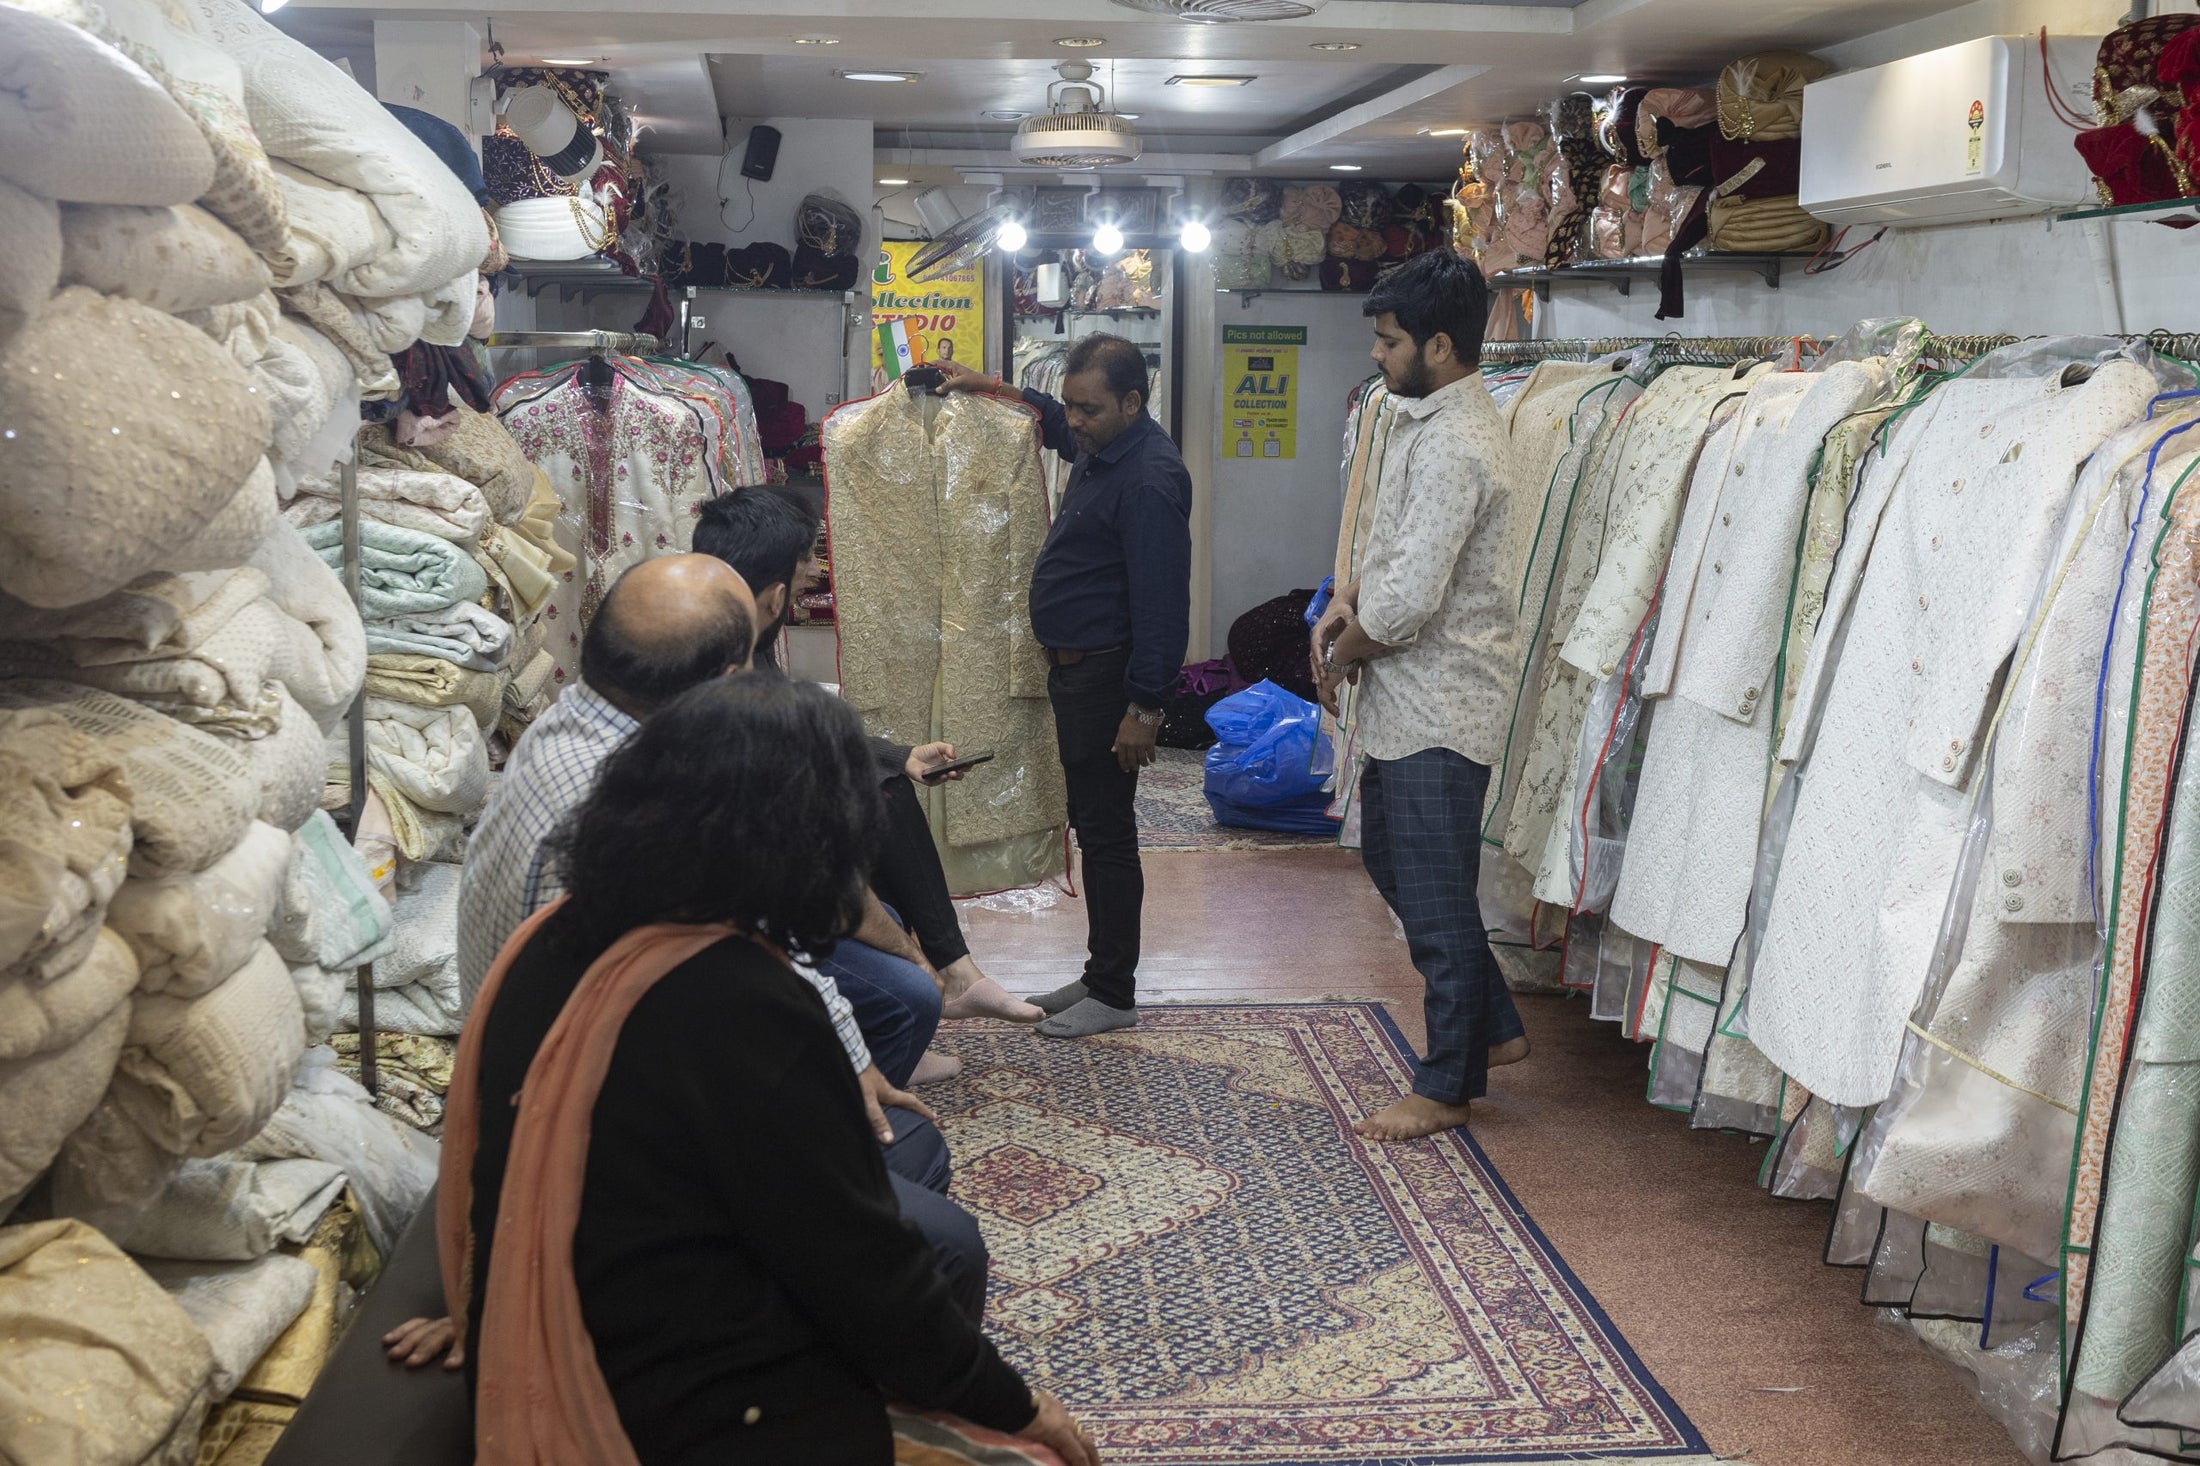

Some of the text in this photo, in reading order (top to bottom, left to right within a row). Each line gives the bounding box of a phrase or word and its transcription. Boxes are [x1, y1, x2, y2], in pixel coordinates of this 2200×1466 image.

[872, 314, 956, 332] STDIO
[1227, 329, 1303, 340] Pics not allowed
[1233, 374, 1289, 396] ALI
[1234, 399, 1287, 409] COLLECTION
